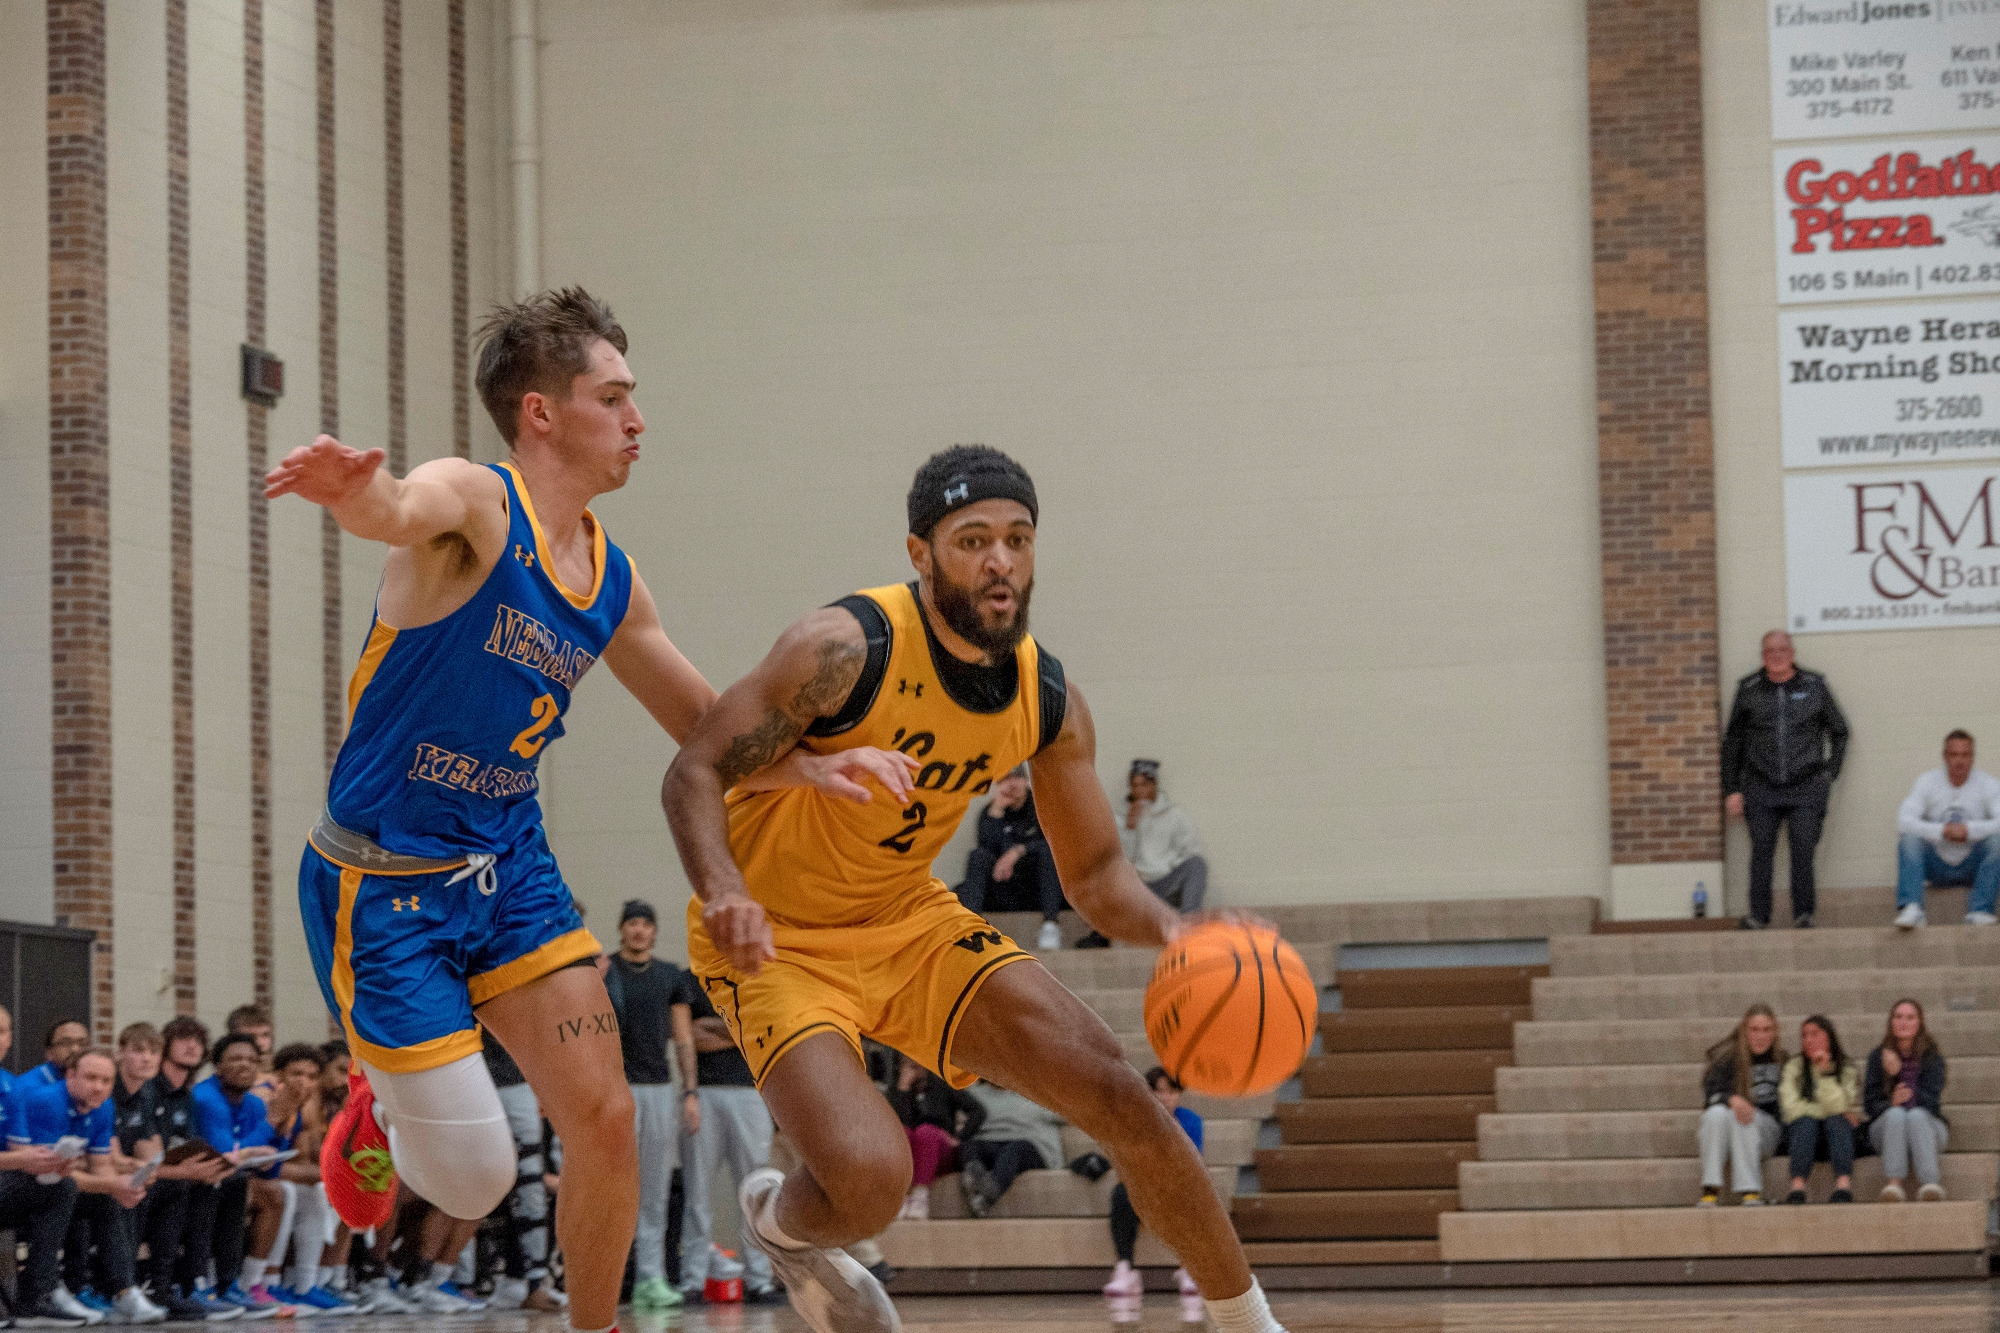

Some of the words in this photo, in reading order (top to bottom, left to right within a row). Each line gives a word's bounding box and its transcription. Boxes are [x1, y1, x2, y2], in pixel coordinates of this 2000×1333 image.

[1790, 54, 1838, 72] Mike
[1844, 51, 1906, 70] Varley
[1951, 45, 1990, 62] Ken
[1787, 78, 1825, 97] 300
[1831, 74, 1881, 93] Main
[1806, 97, 1894, 119] 375-4172
[1788, 273, 1826, 292] 106
[1832, 271, 1848, 289] S
[1854, 266, 1909, 288] Main
[1797, 323, 1911, 352] Wayne
[1789, 354, 1939, 384] Morning
[1896, 394, 1983, 421] 375-2600
[509, 693, 559, 759] 2
[877, 801, 927, 853] 2
